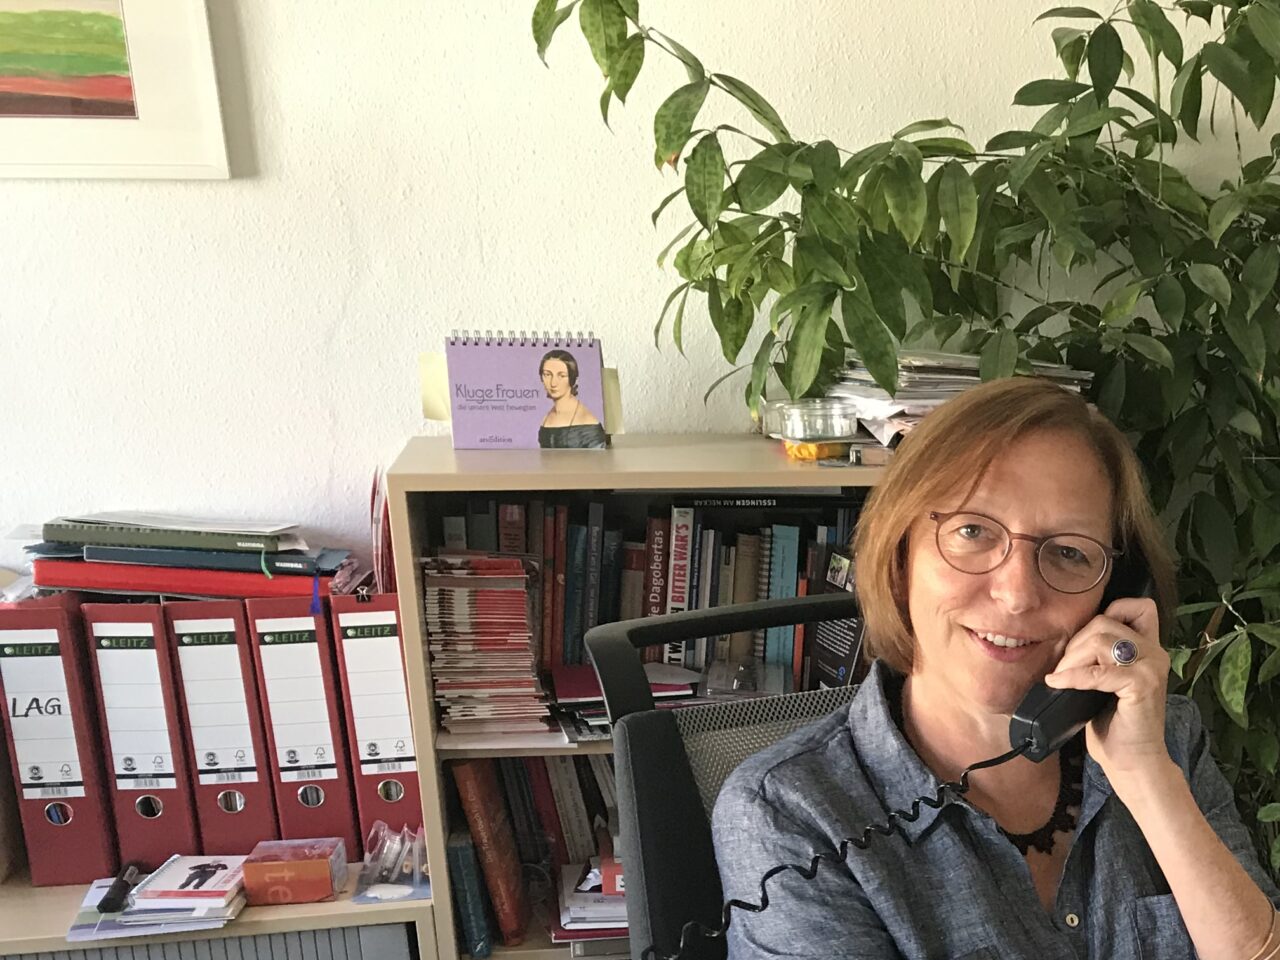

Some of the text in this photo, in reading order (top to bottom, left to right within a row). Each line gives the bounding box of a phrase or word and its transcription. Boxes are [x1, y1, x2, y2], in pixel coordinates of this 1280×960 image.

[455, 384, 539, 404] Kluge Frauen
[735, 499, 777, 507] ESSLINGEN
[673, 523, 688, 561] WAR'S
[649, 530, 665, 603] Dagobertas
[670, 565, 686, 603] BITTER
[274, 631, 311, 643] LEITZ
[357, 625, 392, 638] LEITZ
[112, 637, 148, 649] LEITZ
[193, 633, 230, 645] LEITZ
[14, 643, 54, 656] LEITZ
[12, 697, 62, 719] LAG
